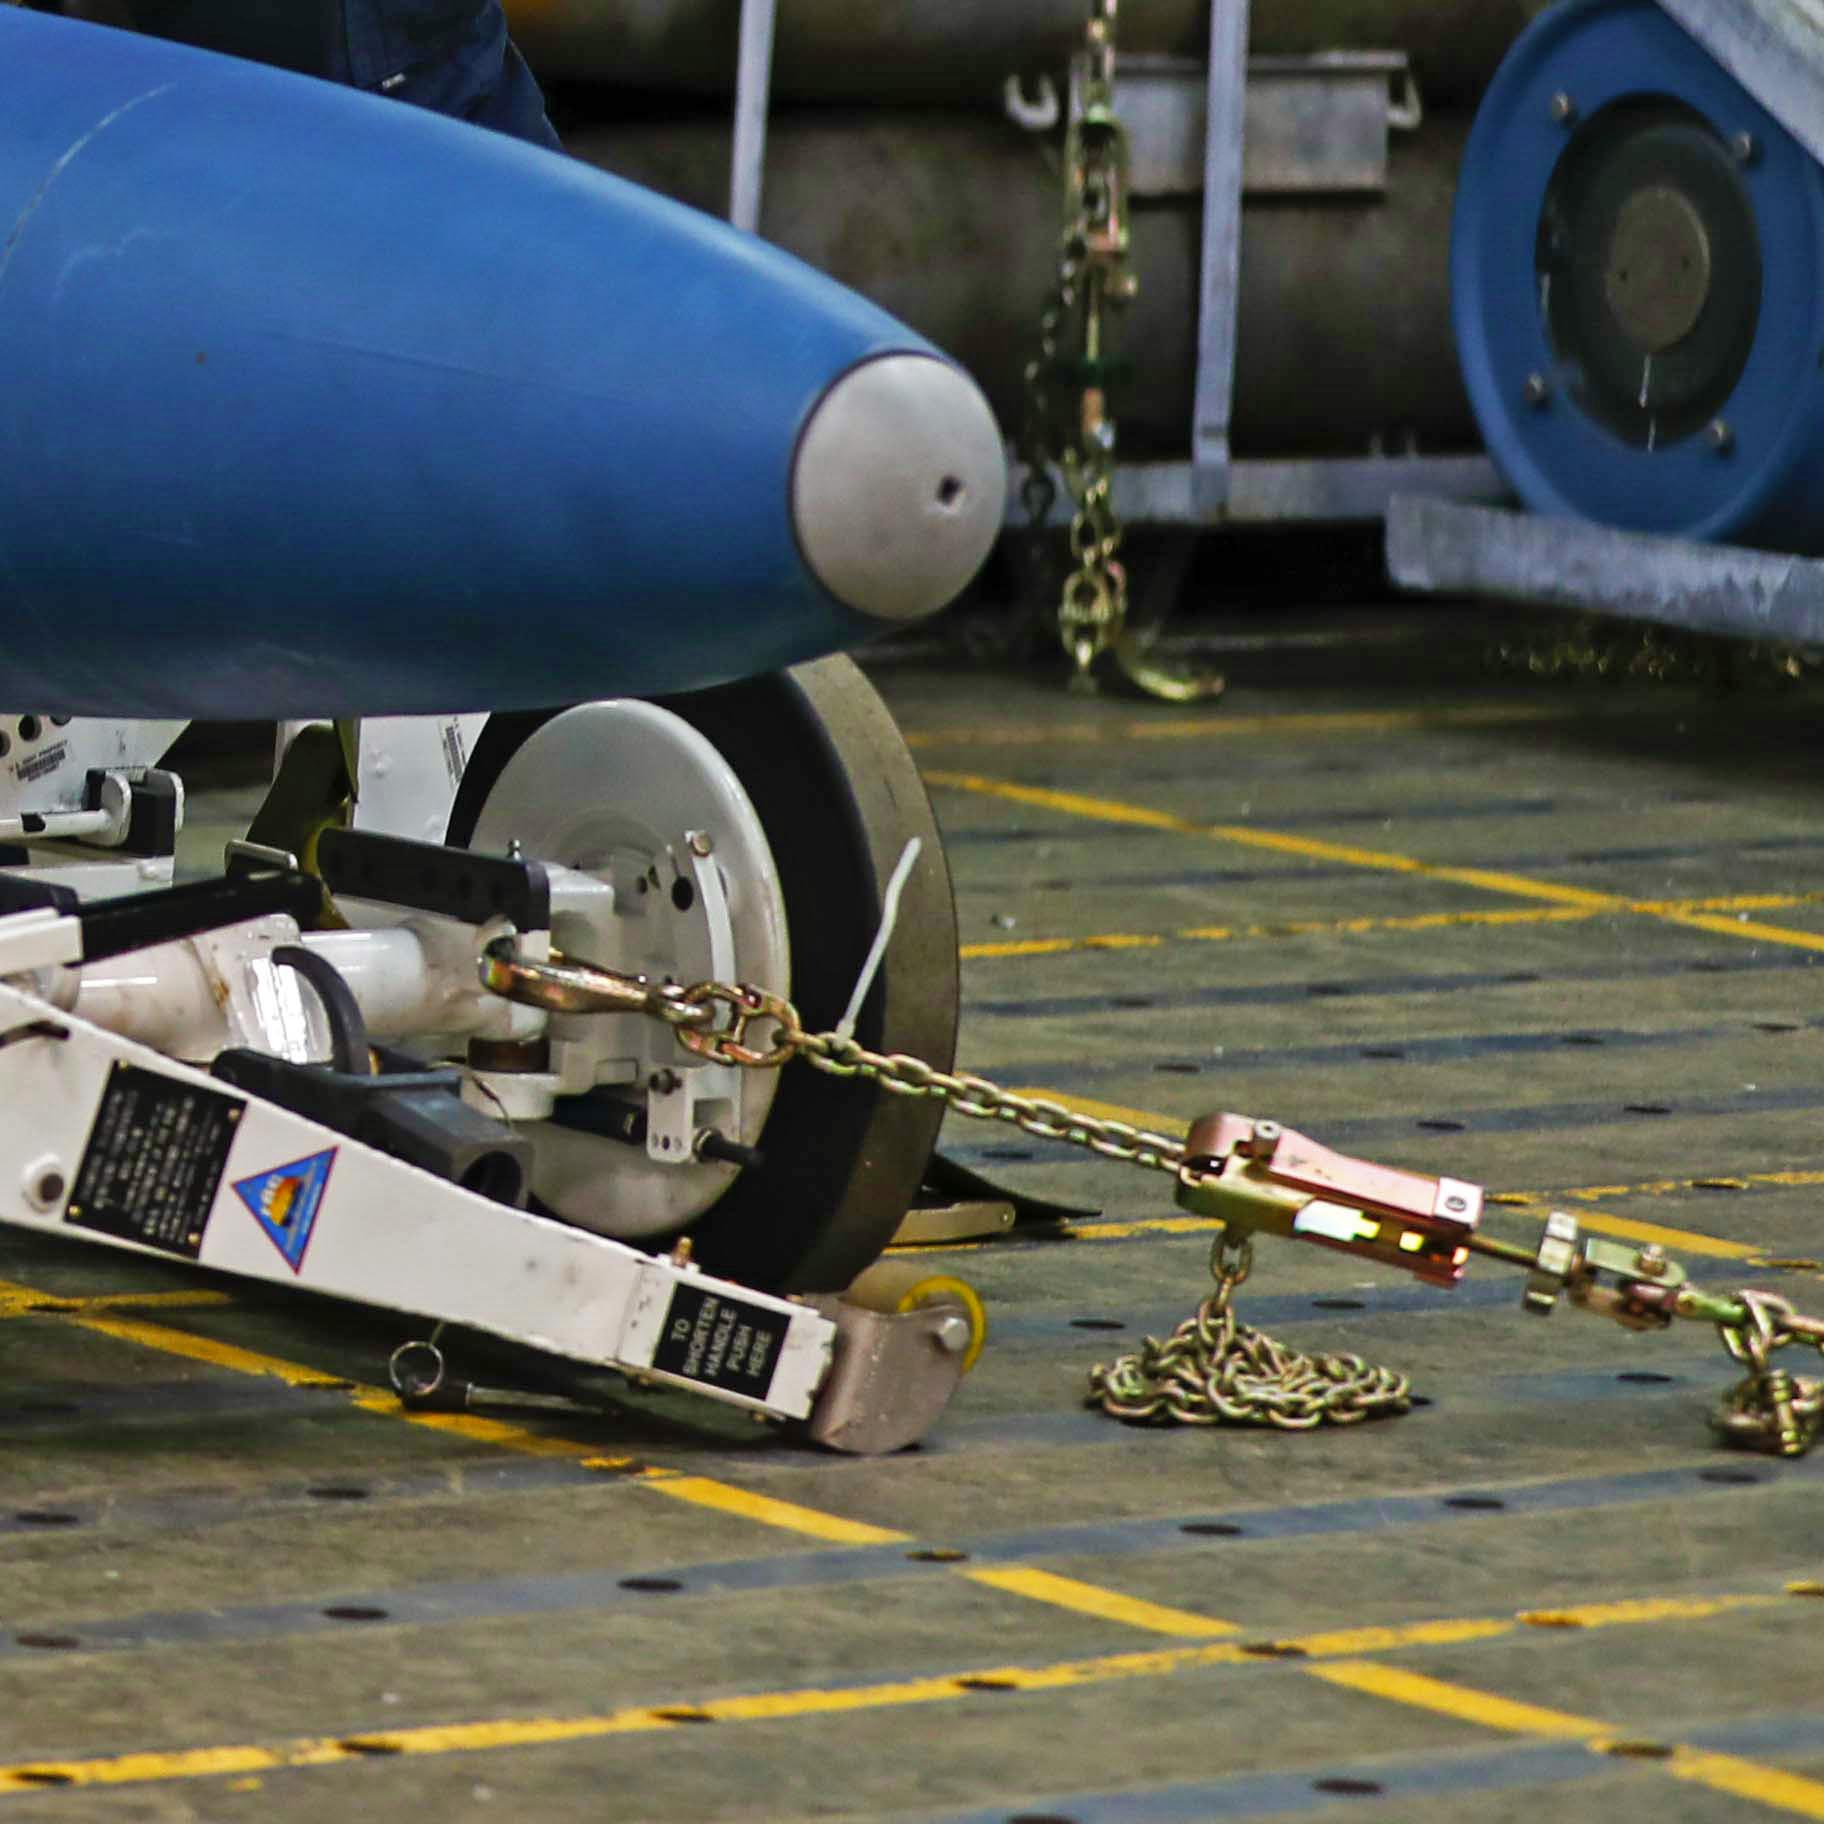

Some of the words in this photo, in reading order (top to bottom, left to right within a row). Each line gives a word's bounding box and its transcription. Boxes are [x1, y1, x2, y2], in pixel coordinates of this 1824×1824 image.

[671, 1318, 690, 1341] TO
[683, 1296, 720, 1375] SHORTEN
[705, 1307, 737, 1376] HANDLE
[726, 1325, 752, 1372] PUSH
[746, 1329, 771, 1377] HERE
